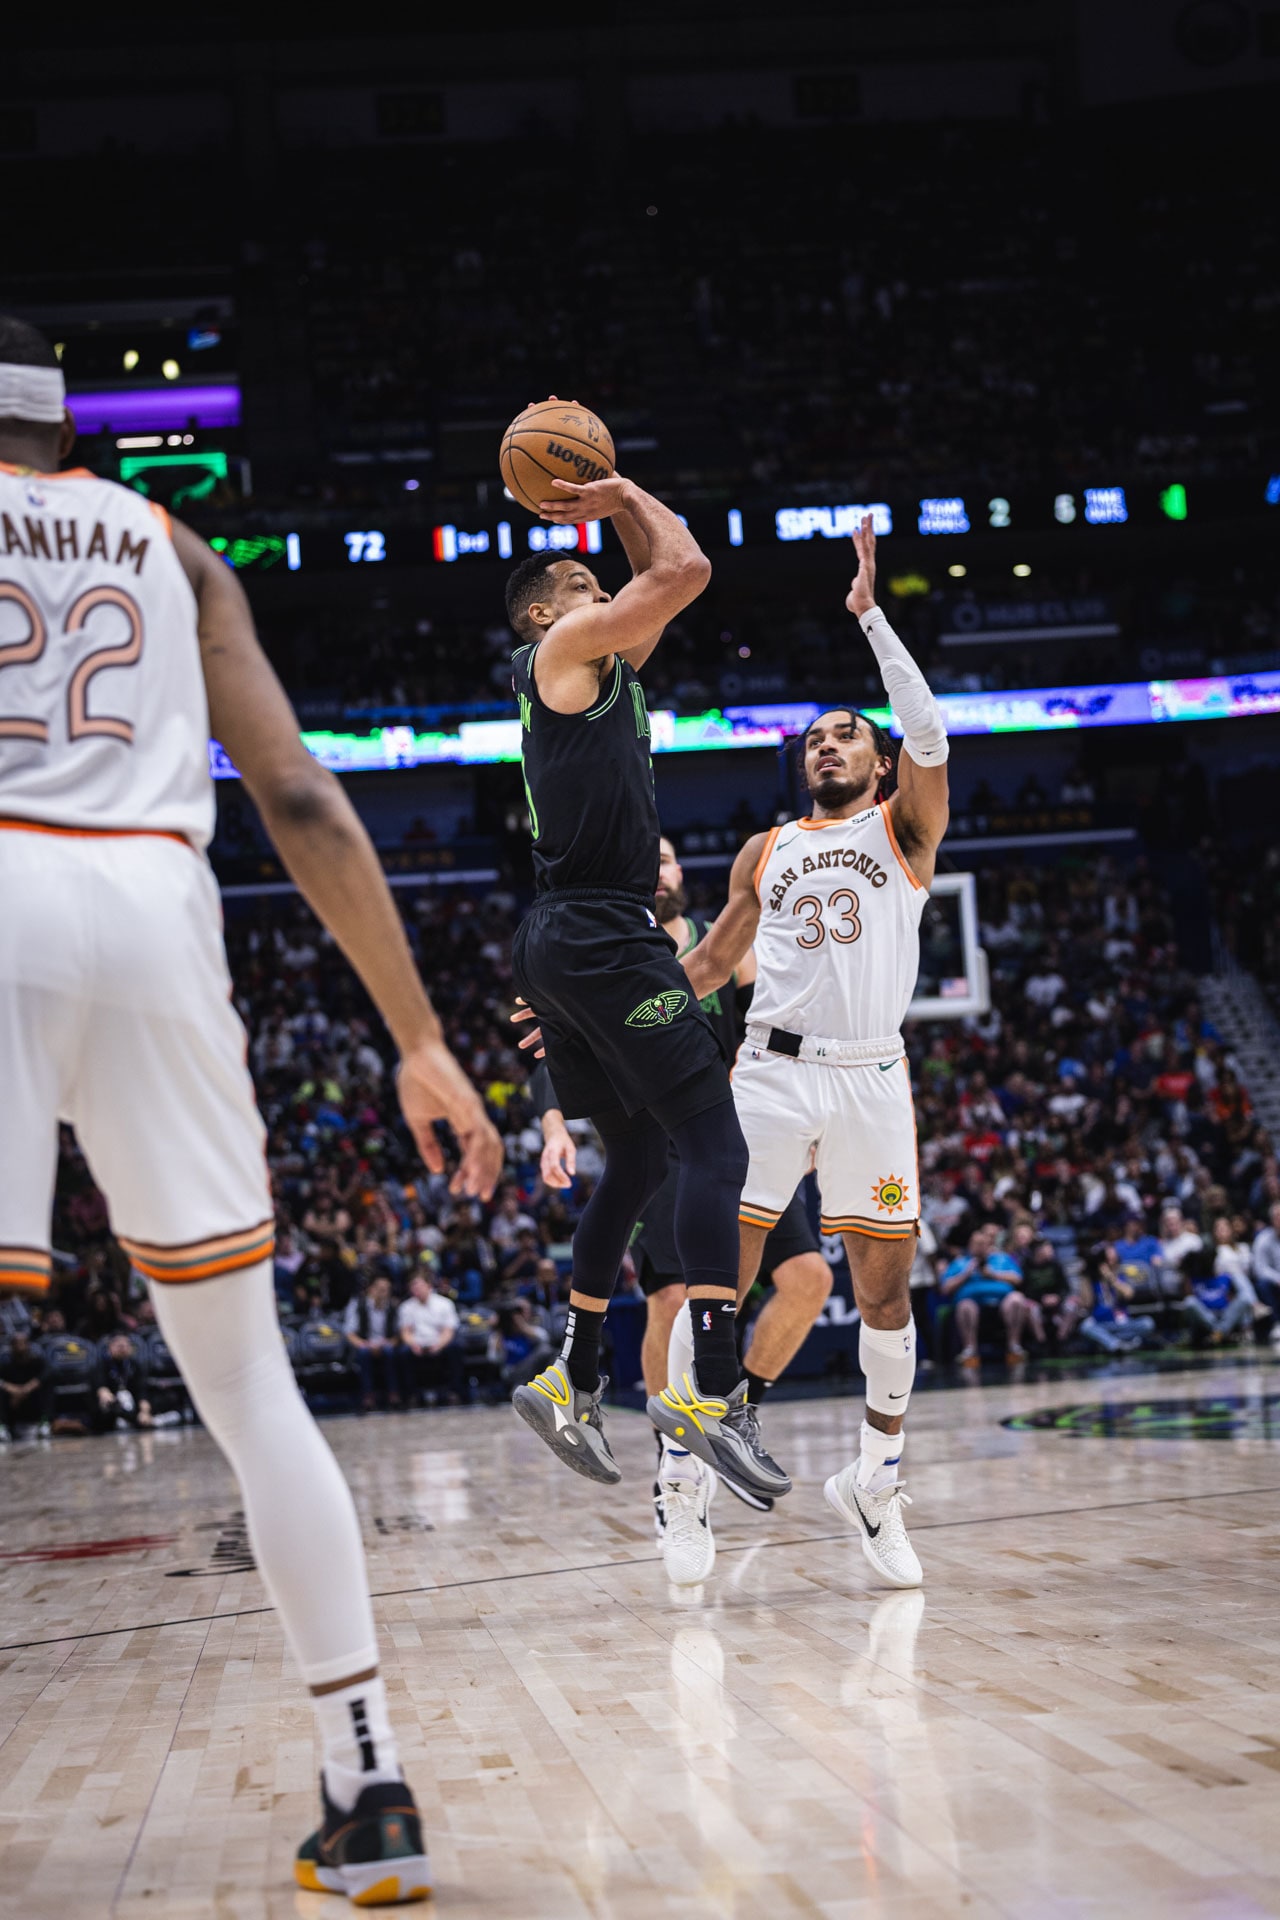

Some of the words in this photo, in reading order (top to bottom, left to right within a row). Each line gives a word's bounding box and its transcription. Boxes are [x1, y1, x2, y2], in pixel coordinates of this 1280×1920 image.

[775, 502, 893, 542] SPURS
[989, 498, 1011, 528] 2
[0, 511, 150, 576] ANHAM
[344, 530, 387, 563] 72
[0, 580, 144, 746] 22
[851, 810, 879, 825] Self.
[769, 866, 798, 913] SAN
[802, 848, 888, 889] ANTONIO
[792, 888, 862, 950] 33
